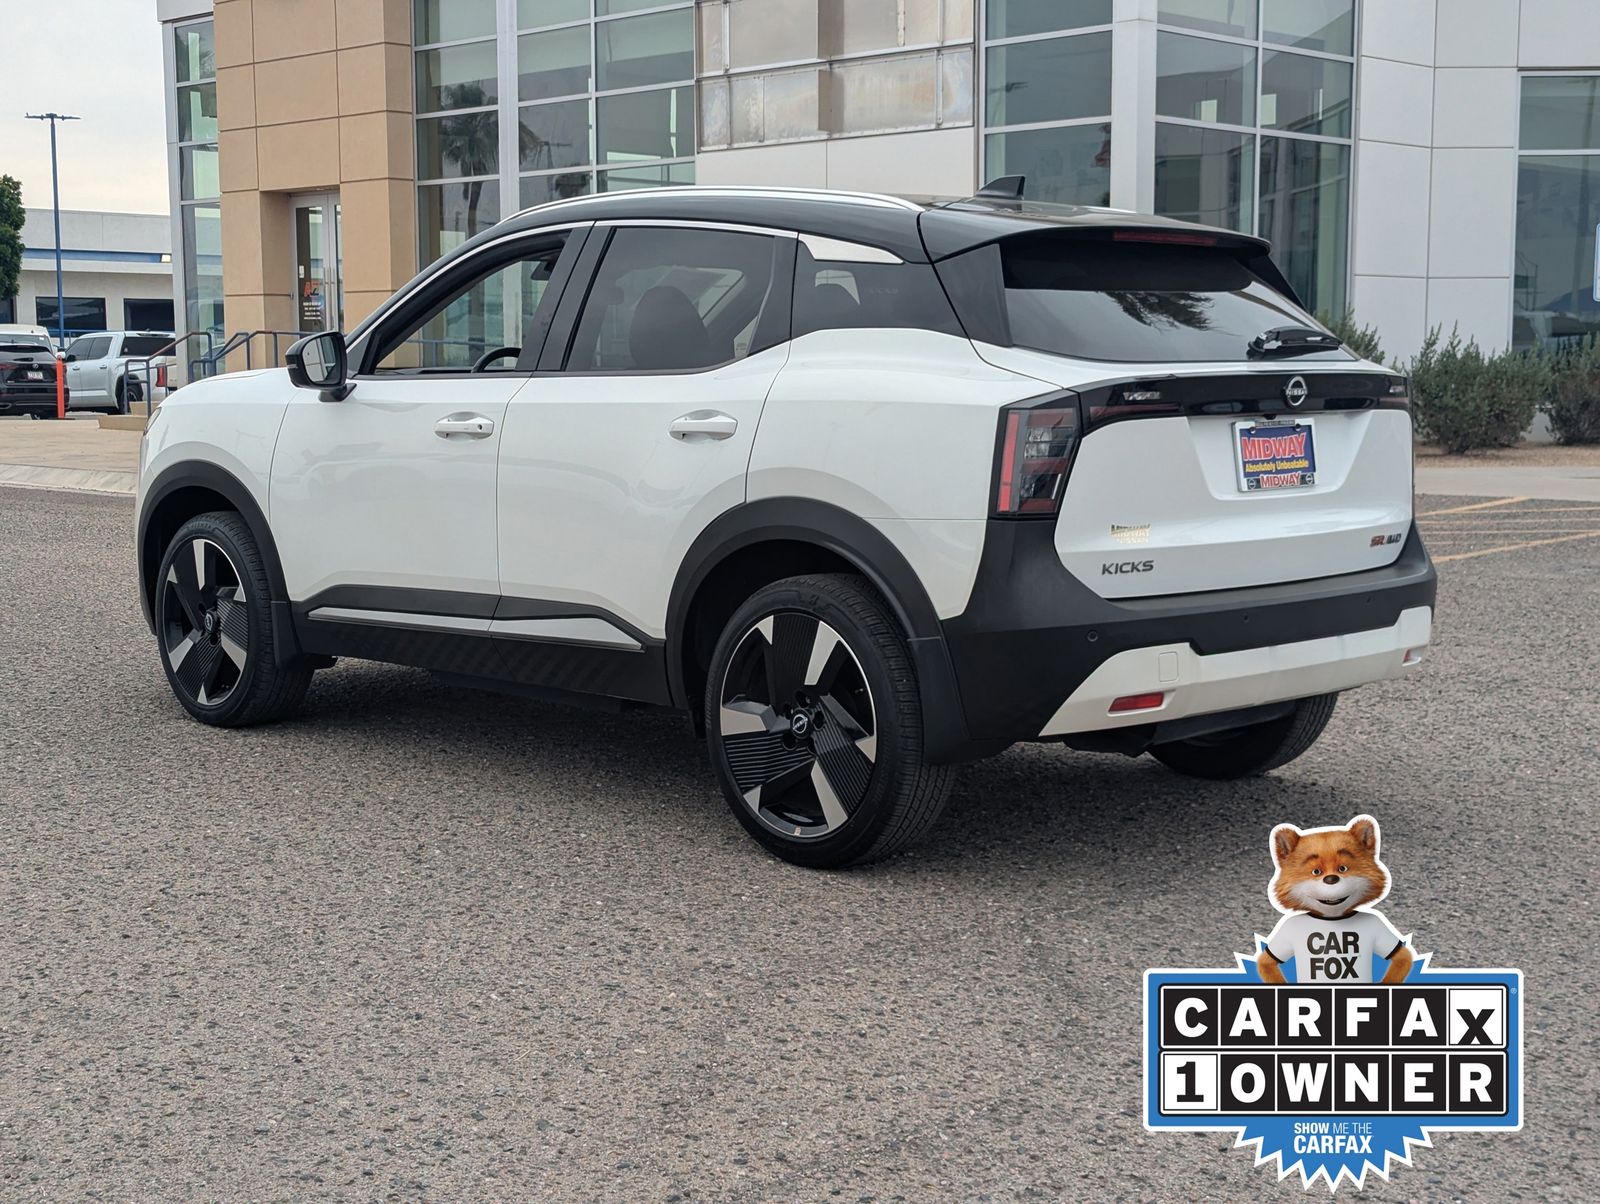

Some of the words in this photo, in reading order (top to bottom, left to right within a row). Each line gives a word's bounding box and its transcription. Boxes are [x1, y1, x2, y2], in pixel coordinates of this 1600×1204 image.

[1241, 432, 1306, 461] MIDWAY
[1245, 462, 1276, 473] Absolutely
[1260, 472, 1301, 488] MIDWAY
[1102, 560, 1154, 575] KICKS
